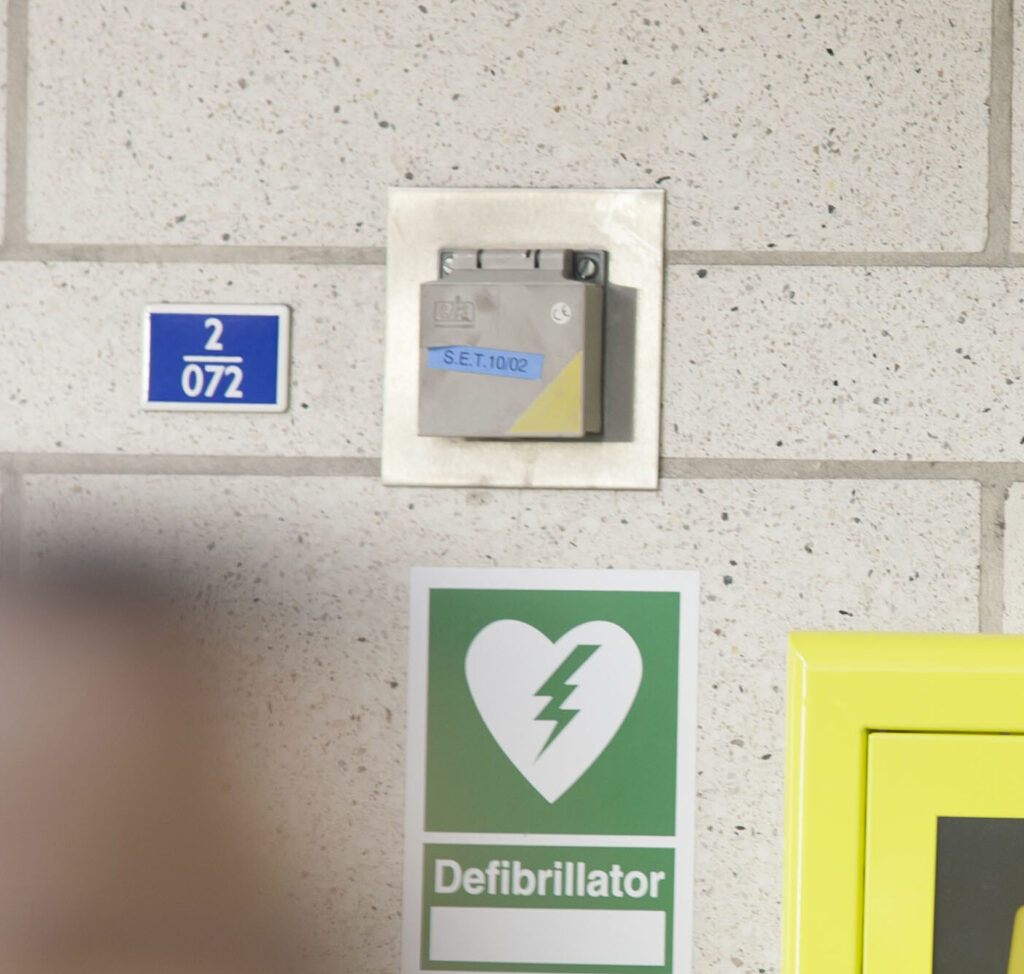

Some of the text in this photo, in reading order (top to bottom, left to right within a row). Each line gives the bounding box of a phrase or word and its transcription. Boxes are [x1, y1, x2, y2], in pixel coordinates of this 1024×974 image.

[204, 317, 224, 351] 2
[443, 349, 528, 373] S.E.T.10/02
[181, 363, 244, 399] 072
[434, 858, 666, 898] Defibrillator
